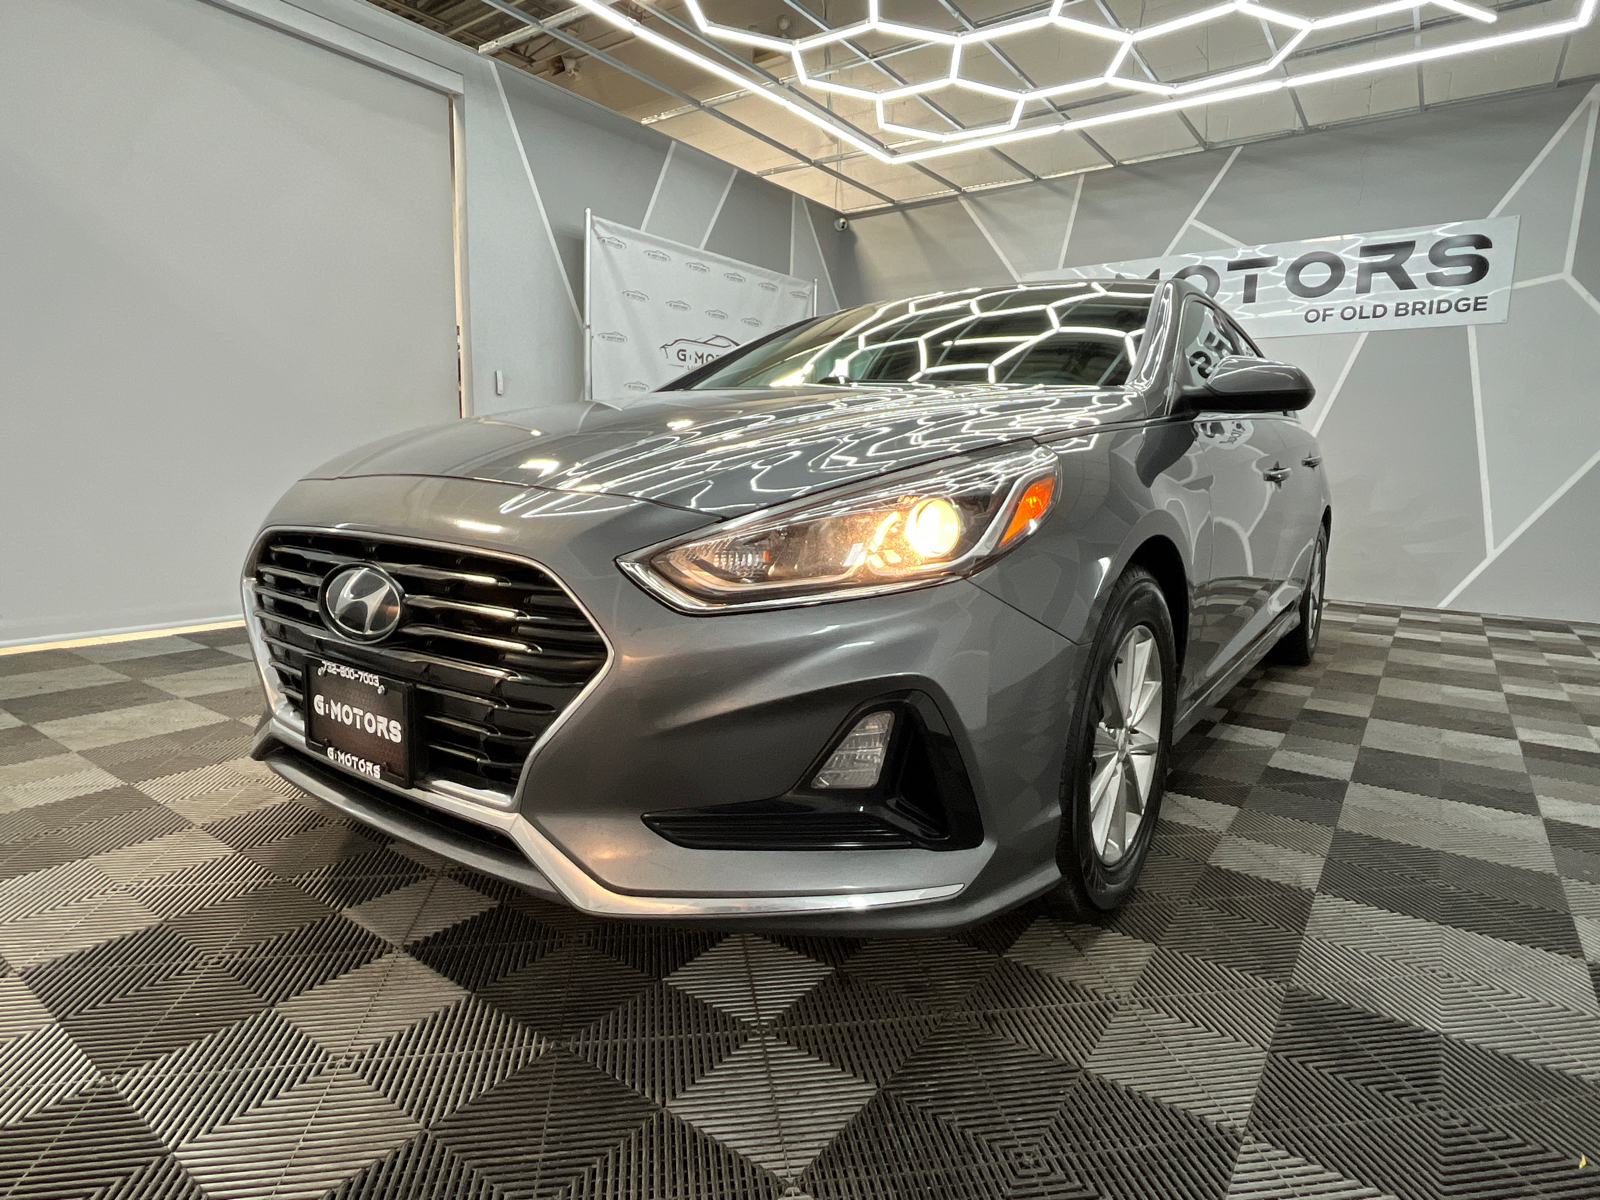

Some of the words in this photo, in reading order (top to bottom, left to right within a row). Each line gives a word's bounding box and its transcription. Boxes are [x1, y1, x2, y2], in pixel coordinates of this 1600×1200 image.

[1115, 234, 1493, 304] OTORS
[1304, 308, 1334, 324] OF
[1340, 304, 1388, 321] OLD
[1394, 296, 1488, 317] BRIDGE
